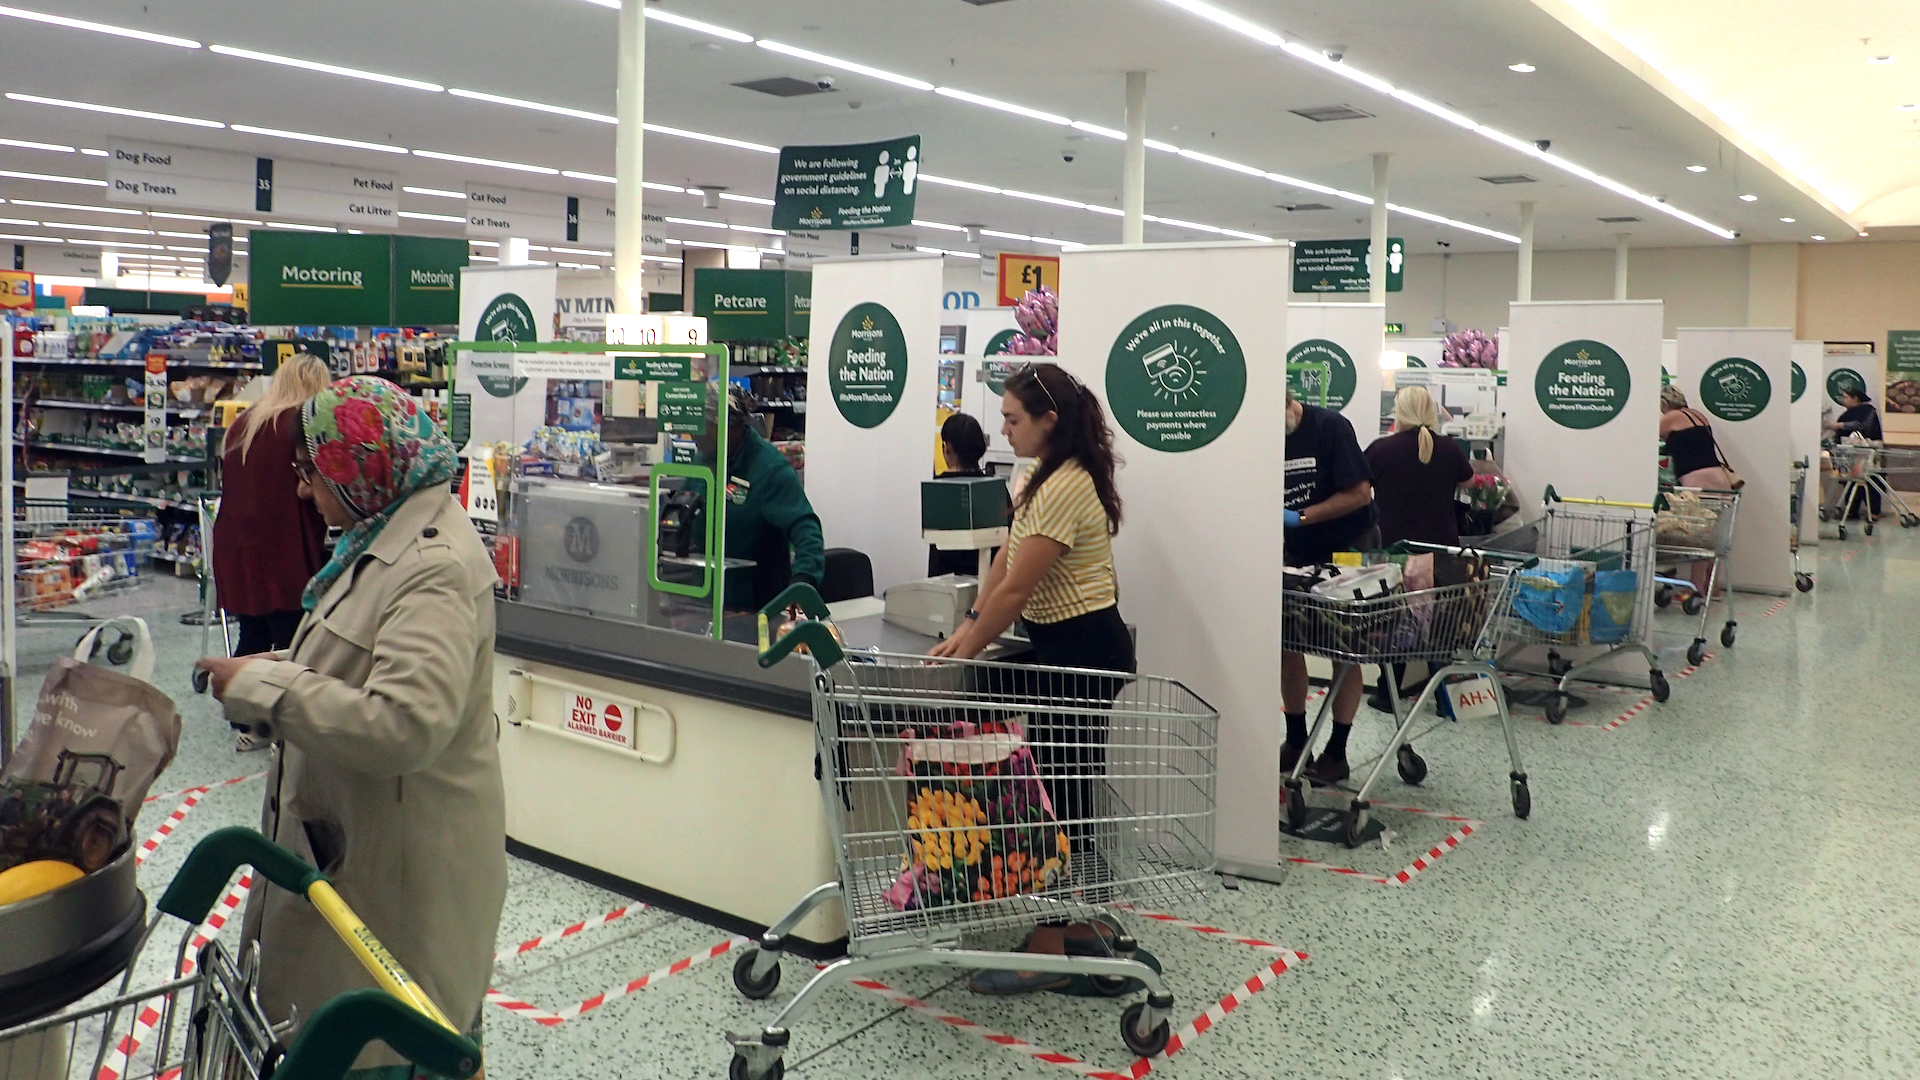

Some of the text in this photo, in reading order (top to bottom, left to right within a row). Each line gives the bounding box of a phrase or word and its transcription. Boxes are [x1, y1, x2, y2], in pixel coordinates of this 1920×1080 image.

[116, 150, 171, 165] Dog Food
[794, 159, 808, 169] We
[823, 158, 859, 169] following
[258, 179, 270, 190] 35
[353, 178, 393, 191] Pet Food
[780, 171, 867, 184] government guidelines
[116, 180, 176, 195] Dog Treats
[796, 186, 819, 195] social
[820, 185, 860, 196] distancing.
[471, 193, 506, 204] Cat Food
[349, 203, 392, 216] Cat Litter
[838, 205, 892, 216] Feeding the Nation
[471, 217, 511, 229] Cat Treats
[799, 218, 832, 226] Morrisons
[645, 236, 663, 245] Chips
[789, 231, 806, 239] Frozen
[282, 265, 363, 287] Motoring
[411, 269, 455, 288] Motoring
[1021, 264, 1042, 293] £1
[715, 294, 767, 308] Petcare
[794, 294, 811, 308] Petca
[640, 328, 656, 345] 10
[688, 329, 698, 345] 9
[851, 329, 883, 339] Morrisons
[1125, 317, 1227, 355] We're all in this together
[847, 347, 886, 367] Feeding
[1564, 358, 1601, 366] Morrisons
[839, 366, 894, 381] the Nation
[1558, 371, 1605, 386] Feeding
[1548, 383, 1615, 397] the Nation
[1136, 409, 1159, 418] Please
[1174, 409, 1216, 418] contactless
[1147, 420, 1207, 431] payments where
[1160, 432, 1192, 442] possible
[44, 691, 79, 713] with
[576, 695, 593, 710] NO
[55, 710, 98, 737] know
[572, 708, 597, 726] EXIT
[568, 721, 626, 744] ALARMED BARRIER
